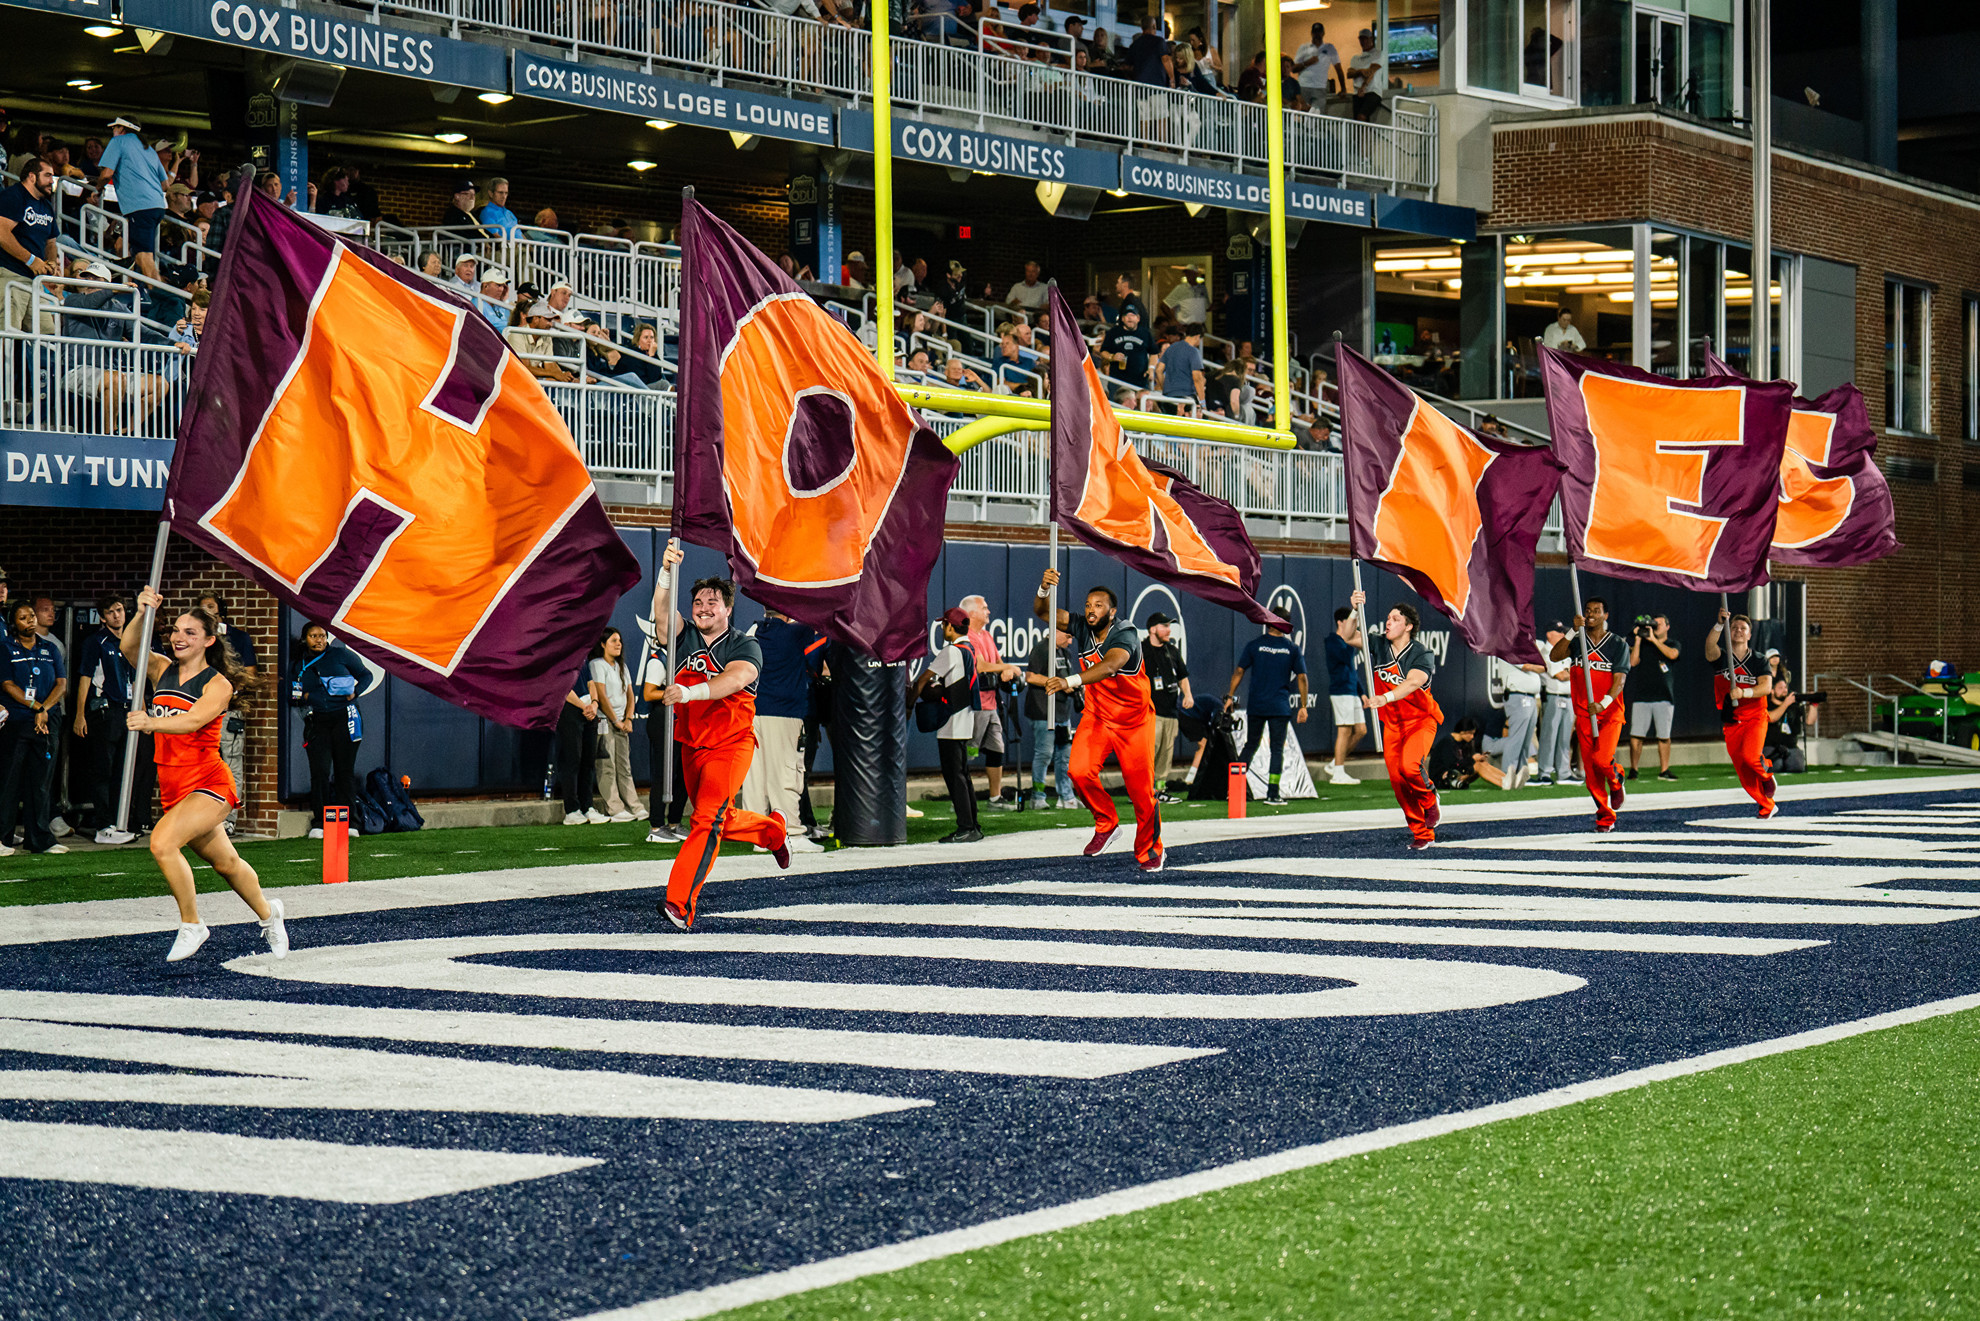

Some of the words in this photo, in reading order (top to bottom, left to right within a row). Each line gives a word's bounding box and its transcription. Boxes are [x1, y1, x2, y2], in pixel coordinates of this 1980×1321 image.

[210, 0, 281, 47] COX
[290, 14, 434, 75] BUSINESS
[290, 102, 298, 120] OX
[525, 63, 566, 92] COX
[571, 71, 657, 108] BUSINESS
[664, 91, 727, 118] LOGE
[736, 102, 830, 135] LOUNGE
[290, 123, 298, 182] BUSINESS
[902, 125, 953, 161] COX
[960, 134, 1065, 179] BUSINESS
[1131, 165, 1163, 188] COX
[1166, 171, 1232, 200] BUSINESS
[1236, 184, 1271, 204] LOG
[1292, 191, 1365, 217] LOUNGE
[199, 240, 596, 677] H
[719, 291, 920, 588] O
[6, 451, 75, 485] DAY
[84, 455, 170, 489] TUNN
[1578, 369, 1747, 580] E
[1575, 657, 1613, 672] HKIES
[1289, 693, 1318, 709] OTRY
